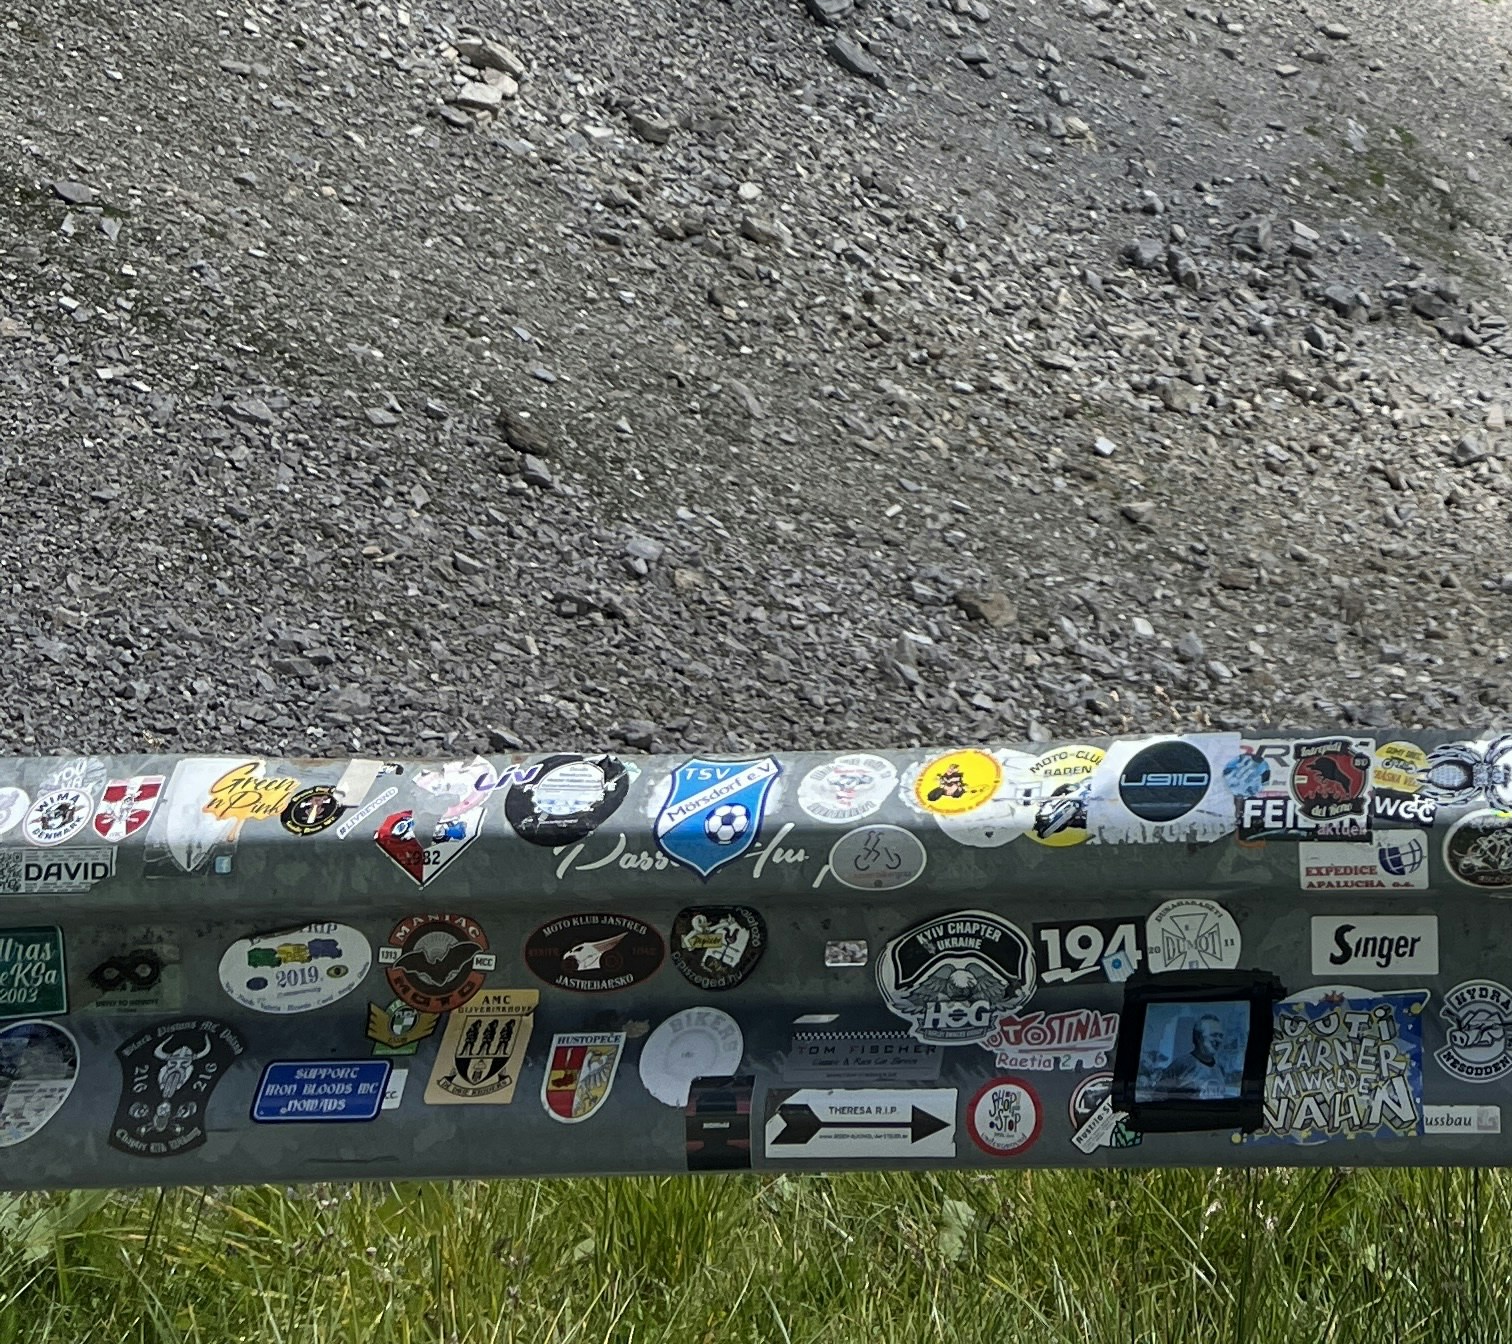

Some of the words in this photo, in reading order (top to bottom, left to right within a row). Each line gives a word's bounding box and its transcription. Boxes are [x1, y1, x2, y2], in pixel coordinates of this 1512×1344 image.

[210, 762, 295, 795] Green
[685, 767, 730, 781] TSV
[35, 793, 81, 813] WIMA
[666, 777, 742, 823] Mörsdorf
[32, 815, 83, 840] DENMARK
[24, 863, 109, 882] DAVID
[1305, 865, 1378, 877] EXPEDICE
[1306, 880, 1386, 889] APALUCHA
[394, 914, 482, 940] MANIAC
[542, 918, 571, 937] MOTO
[572, 915, 600, 927] KLUB
[600, 914, 648, 936] JASTREB
[916, 923, 944, 945] KYIV
[947, 922, 1003, 943] CHAPTER
[936, 936, 982, 950] UKRAINE
[1329, 924, 1421, 969] Singer
[475, 957, 494, 968] MCC
[275, 966, 320, 989] 2019
[393, 976, 478, 1009] MOTO
[481, 995, 511, 1005] AMC
[1455, 986, 1512, 1011] HYDRA
[923, 999, 991, 1030] HOG
[557, 1033, 622, 1045] HUSTOPEČE
[798, 1045, 836, 1056] TOM
[849, 1044, 937, 1056] FISCHER
[996, 1053, 1052, 1069] Raetia
[1443, 1050, 1511, 1078] NESODDEN
[302, 1082, 353, 1096] BLOODS
[828, 1105, 873, 1115] THERESA
